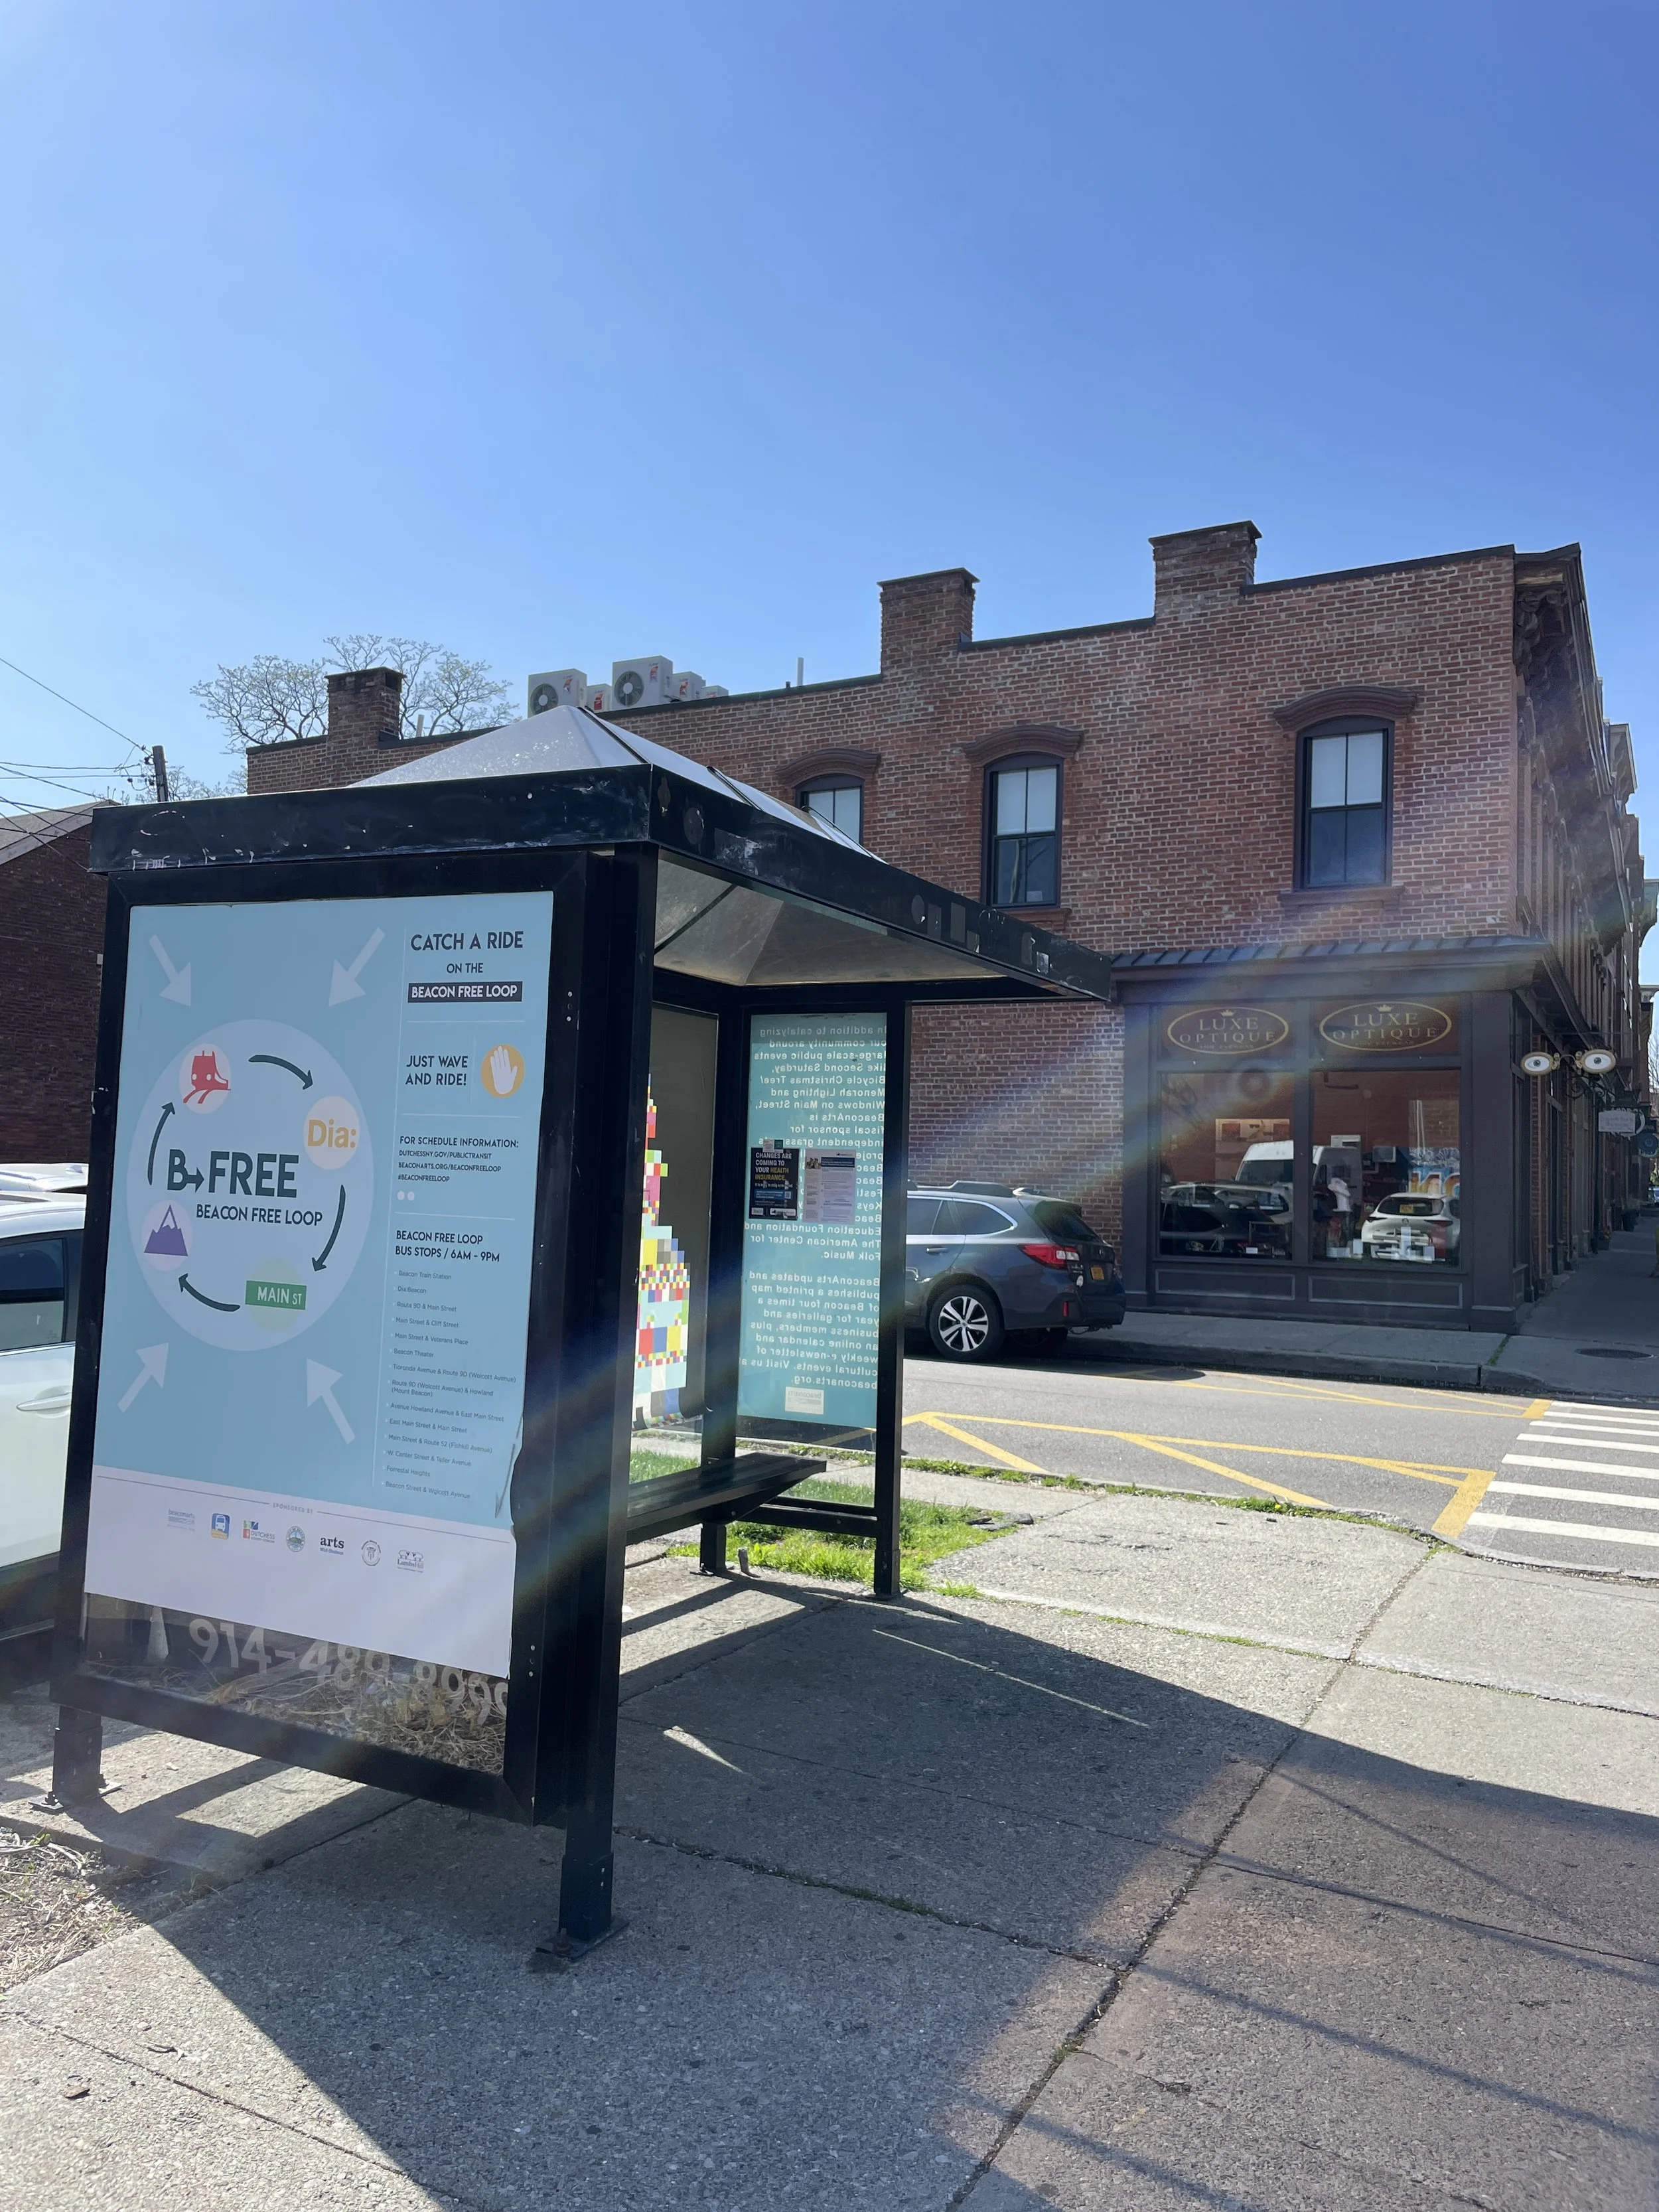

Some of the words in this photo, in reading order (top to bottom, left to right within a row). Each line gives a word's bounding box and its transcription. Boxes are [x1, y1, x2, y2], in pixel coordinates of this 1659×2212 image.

[411, 932, 464, 950] CATCH
[469, 932, 481, 949] A
[487, 931, 524, 949] RIDE
[447, 963, 462, 973] ON
[465, 962, 483, 973] THE
[411, 986, 455, 998] BEACON
[458, 986, 483, 997] FREE
[486, 985, 518, 997] LOOP
[1198, 1017, 1259, 1031] LUXE
[1353, 1013, 1419, 1027] LUXE
[1179, 1031, 1276, 1046] OPTIQUE
[1333, 1027, 1437, 1041] OPTIQUE
[406, 1055, 435, 1068] JUST
[438, 1056, 468, 1068] WAVE
[405, 1073, 431, 1085] AND
[436, 1073, 467, 1086] RIDE!
[307, 1119, 356, 1148] Dia:
[399, 1136, 415, 1145] FOR
[418, 1137, 457, 1146] SCHEDULE
[460, 1138, 519, 1148] INFORMATION:
[399, 1149, 492, 1159] DUTCHESSNY.GOV/PUBLICTRANSIT
[398, 1162, 502, 1172] BEACONARTS.ORG/BEACONFREELOOP
[208, 1151, 299, 1198] FREE
[196, 1204, 248, 1222] BEACON
[252, 1207, 281, 1224] FREE
[285, 1209, 323, 1226] LOOP
[396, 1230, 432, 1242] BEACON
[435, 1232, 455, 1243] FREE
[457, 1234, 483, 1244] LOOP
[396, 1246, 412, 1256] BUS
[414, 1247, 441, 1258] STOPS
[451, 1249, 471, 1260] 6AM
[480, 1252, 500, 1262] 9PM
[257, 1286, 289, 1304] MAIN
[292, 1293, 302, 1305] ST
[411, 1389, 433, 1398] Beacon)
[470, 1388, 493, 1396] Howland
[251, 1530, 275, 1540] DUTCHESS
[320, 1536, 344, 1549] arts
